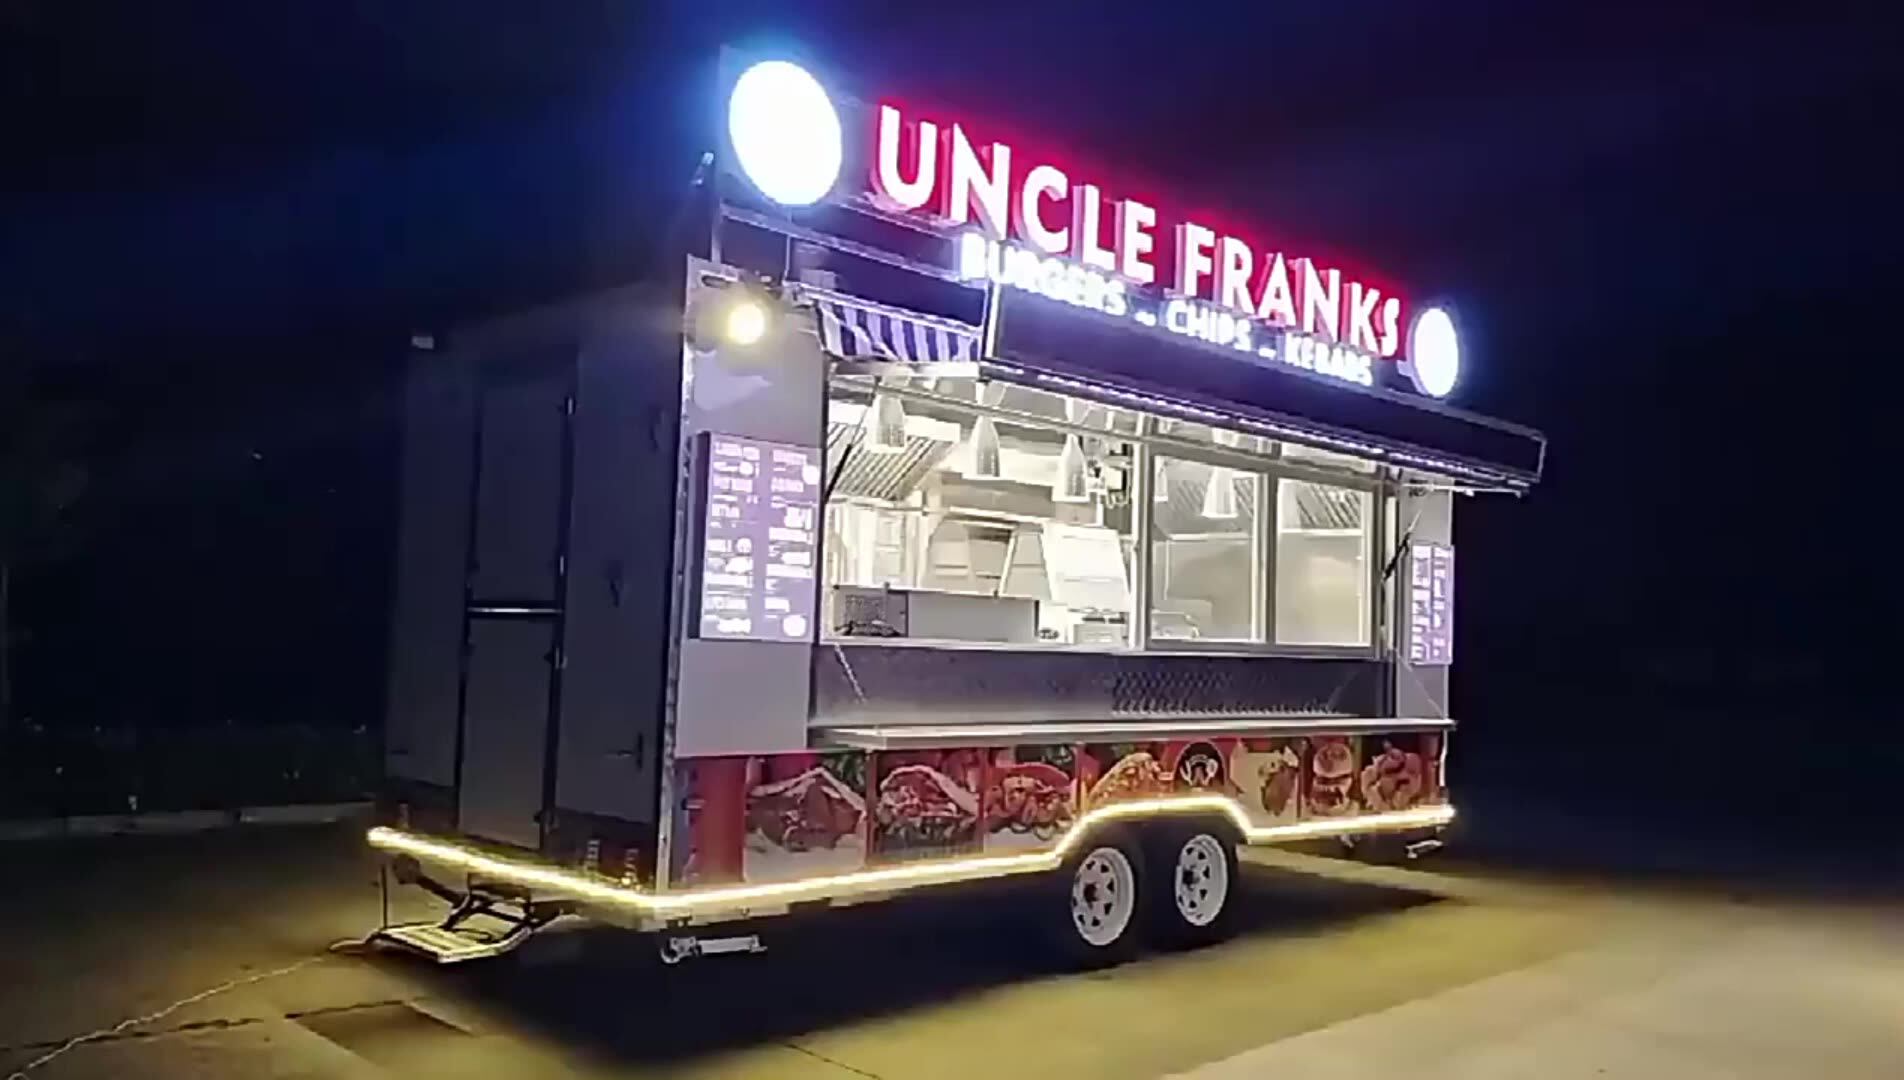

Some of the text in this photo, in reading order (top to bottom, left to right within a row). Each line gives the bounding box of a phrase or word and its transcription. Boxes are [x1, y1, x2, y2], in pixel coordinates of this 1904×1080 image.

[878, 104, 1401, 358] UNCLE FRANKS
[961, 232, 1128, 316] BURGERS
[1166, 299, 1252, 352] CHIPS
[1285, 331, 1374, 387] KEBABS
